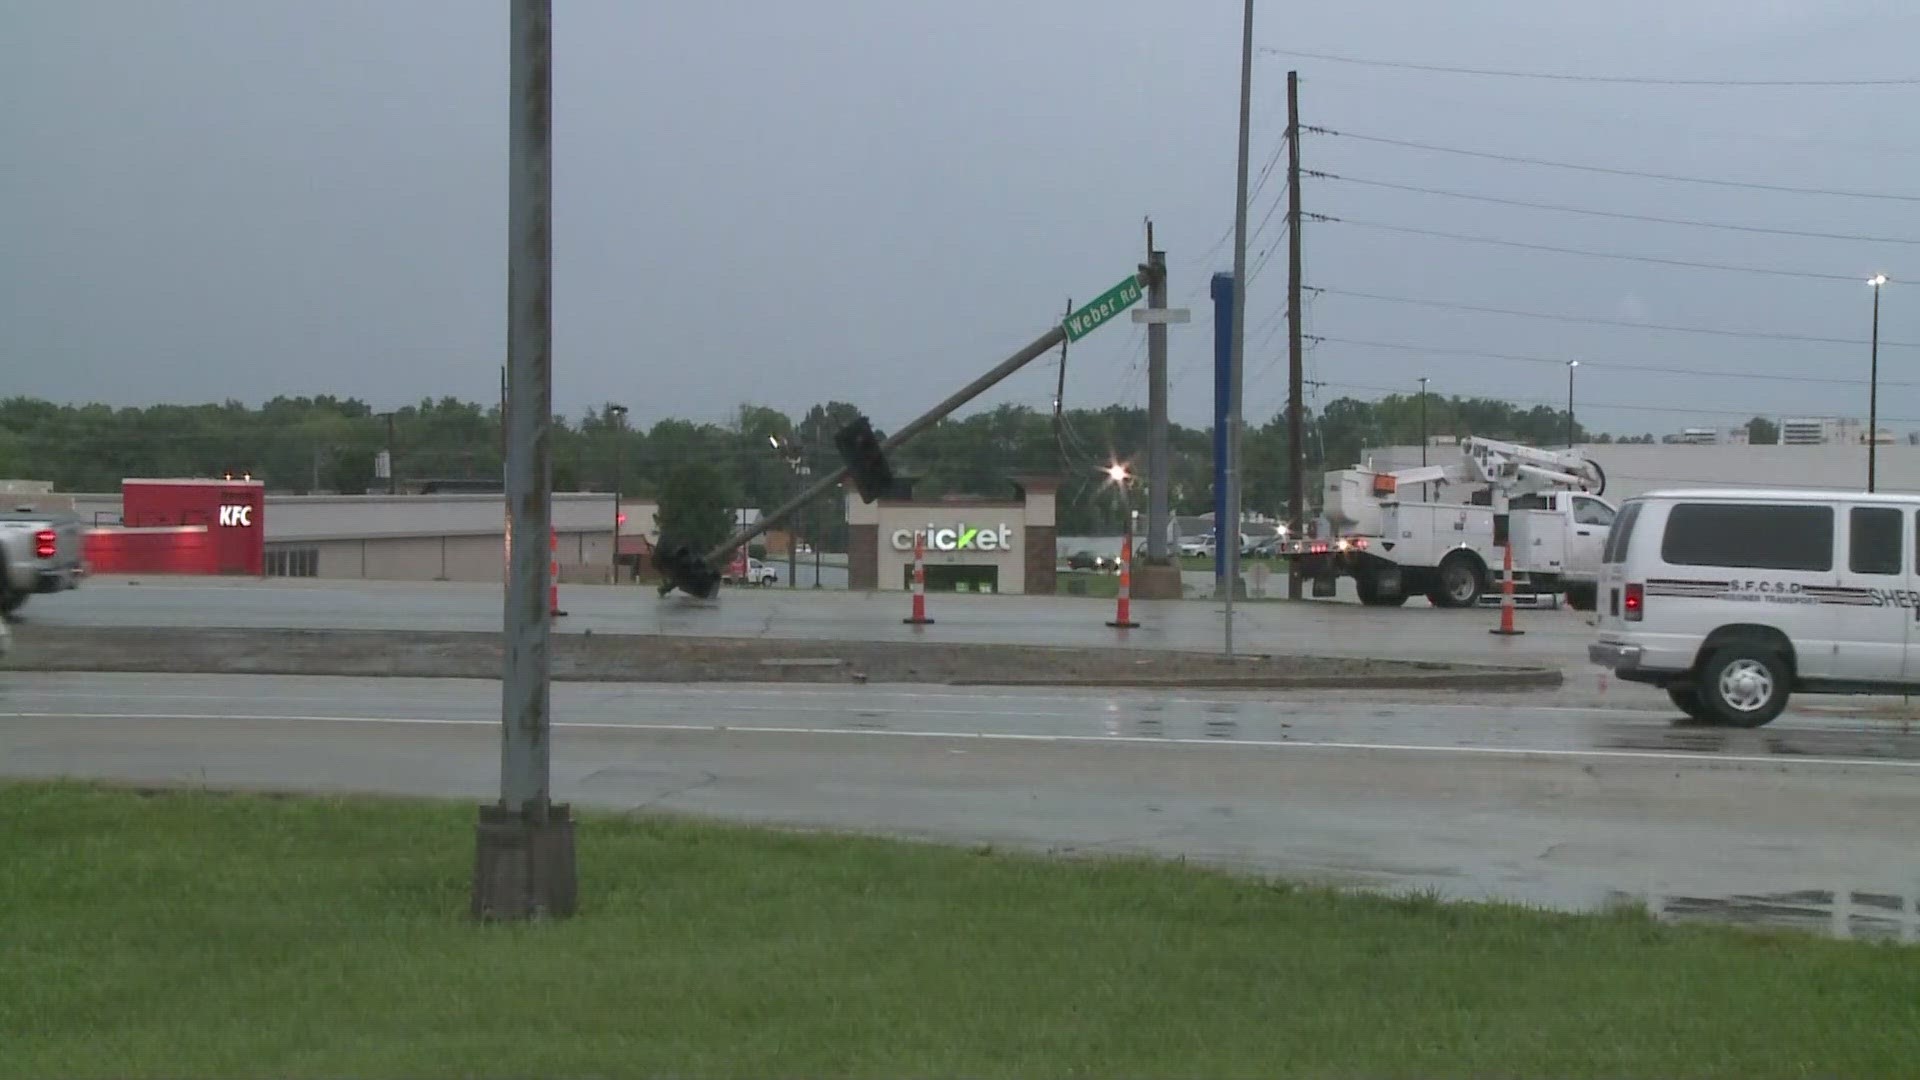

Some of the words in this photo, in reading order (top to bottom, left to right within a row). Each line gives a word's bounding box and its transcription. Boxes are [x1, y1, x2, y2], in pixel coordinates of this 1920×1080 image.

[1069, 297, 1114, 335] Weber
[1120, 285, 1138, 304] Rd
[219, 505, 252, 527] KFC
[891, 522, 1012, 551] cricket
